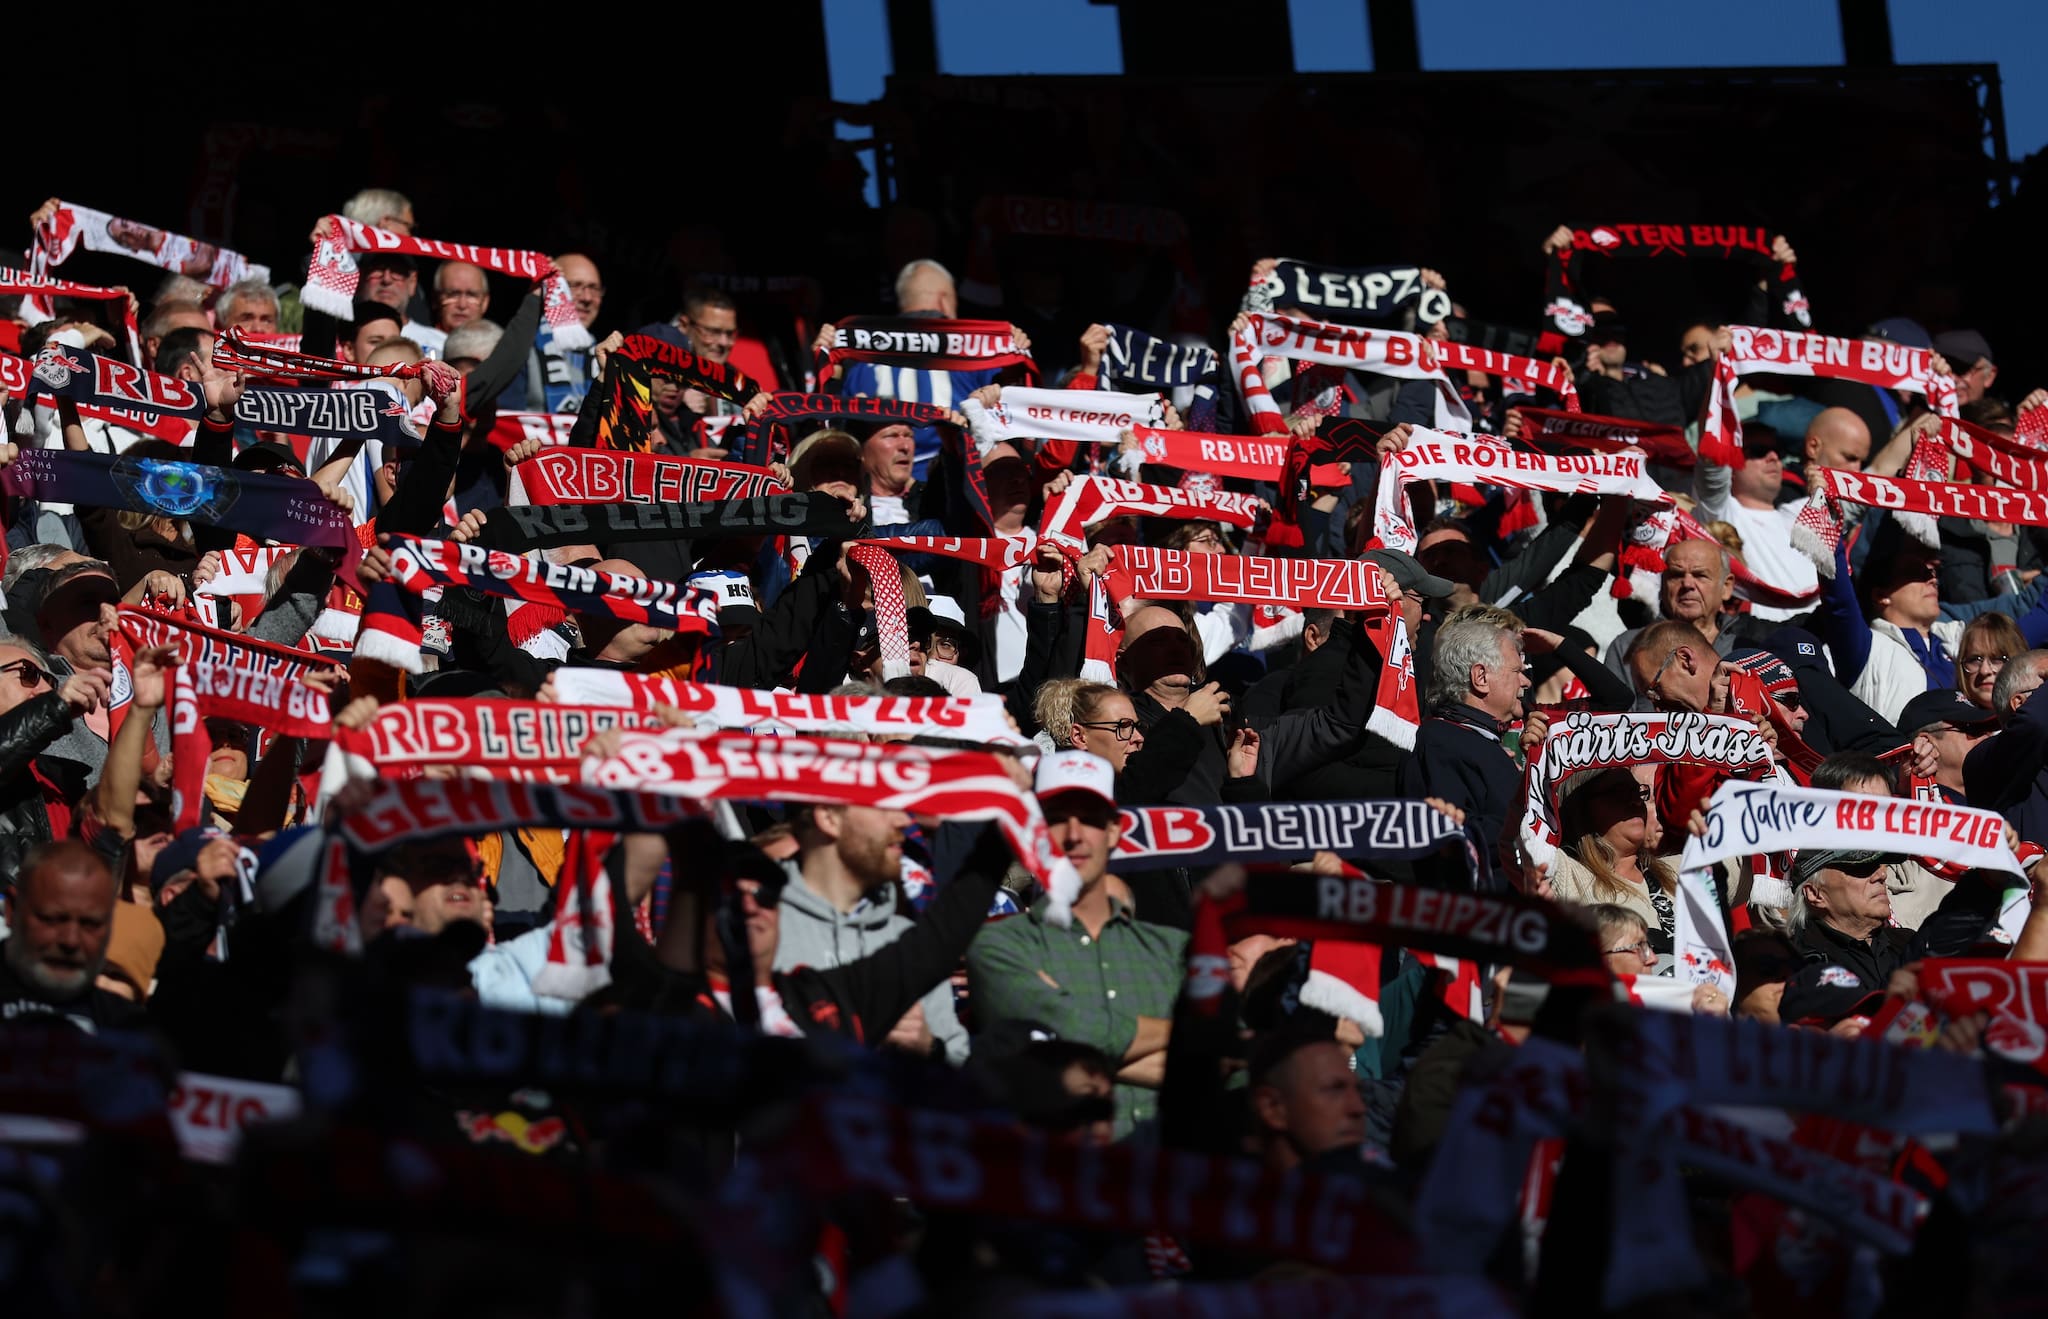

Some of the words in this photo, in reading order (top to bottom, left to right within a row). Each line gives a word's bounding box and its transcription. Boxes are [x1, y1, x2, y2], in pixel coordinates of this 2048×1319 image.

[338, 214, 401, 250] RB
[412, 236, 539, 279] LEIPZIG
[1689, 223, 1774, 259] BULL
[853, 328, 940, 355] ROTEN
[945, 332, 1018, 358] BULL
[1121, 329, 1217, 384] LEIPZ
[1252, 312, 1371, 360] ROTEN
[1732, 328, 1851, 368] ROTEN
[1860, 340, 1932, 380] BUL
[91, 353, 199, 412] RB
[233, 388, 379, 433] EIPZIG
[535, 452, 621, 501] RB
[1200, 438, 1235, 463] RB
[1236, 442, 1288, 466] LEIPZ
[1395, 444, 1446, 468] DIE
[1454, 443, 1547, 472] ROTEN
[1556, 455, 1640, 479] BULLEN
[286, 508, 324, 527] ARENA
[506, 503, 589, 539] RB
[604, 491, 810, 531] LEIPZIG
[1099, 476, 1145, 502] RB
[1150, 484, 1259, 523] LEIPZIG
[1830, 469, 1908, 509] RB
[1919, 482, 2048, 523] LEIPZI
[390, 538, 448, 585] DIE
[459, 542, 601, 595] ROTEN
[607, 571, 719, 621] BULLE
[1123, 544, 1192, 594] RB
[1206, 552, 1389, 607] LEIPZIG
[195, 660, 284, 711] ROTEN
[739, 686, 972, 728] LEIPZIG
[373, 702, 472, 763] RB
[1656, 710, 1770, 768] Rase
[692, 738, 932, 793] LEIPZIG
[1733, 787, 1829, 845] Jahre
[1835, 798, 1875, 830] RB
[1885, 804, 2002, 849] LEIPZIG
[1315, 875, 1378, 922] RB
[1388, 883, 1551, 955] LEIPZIG
[822, 1094, 985, 1206] RB
